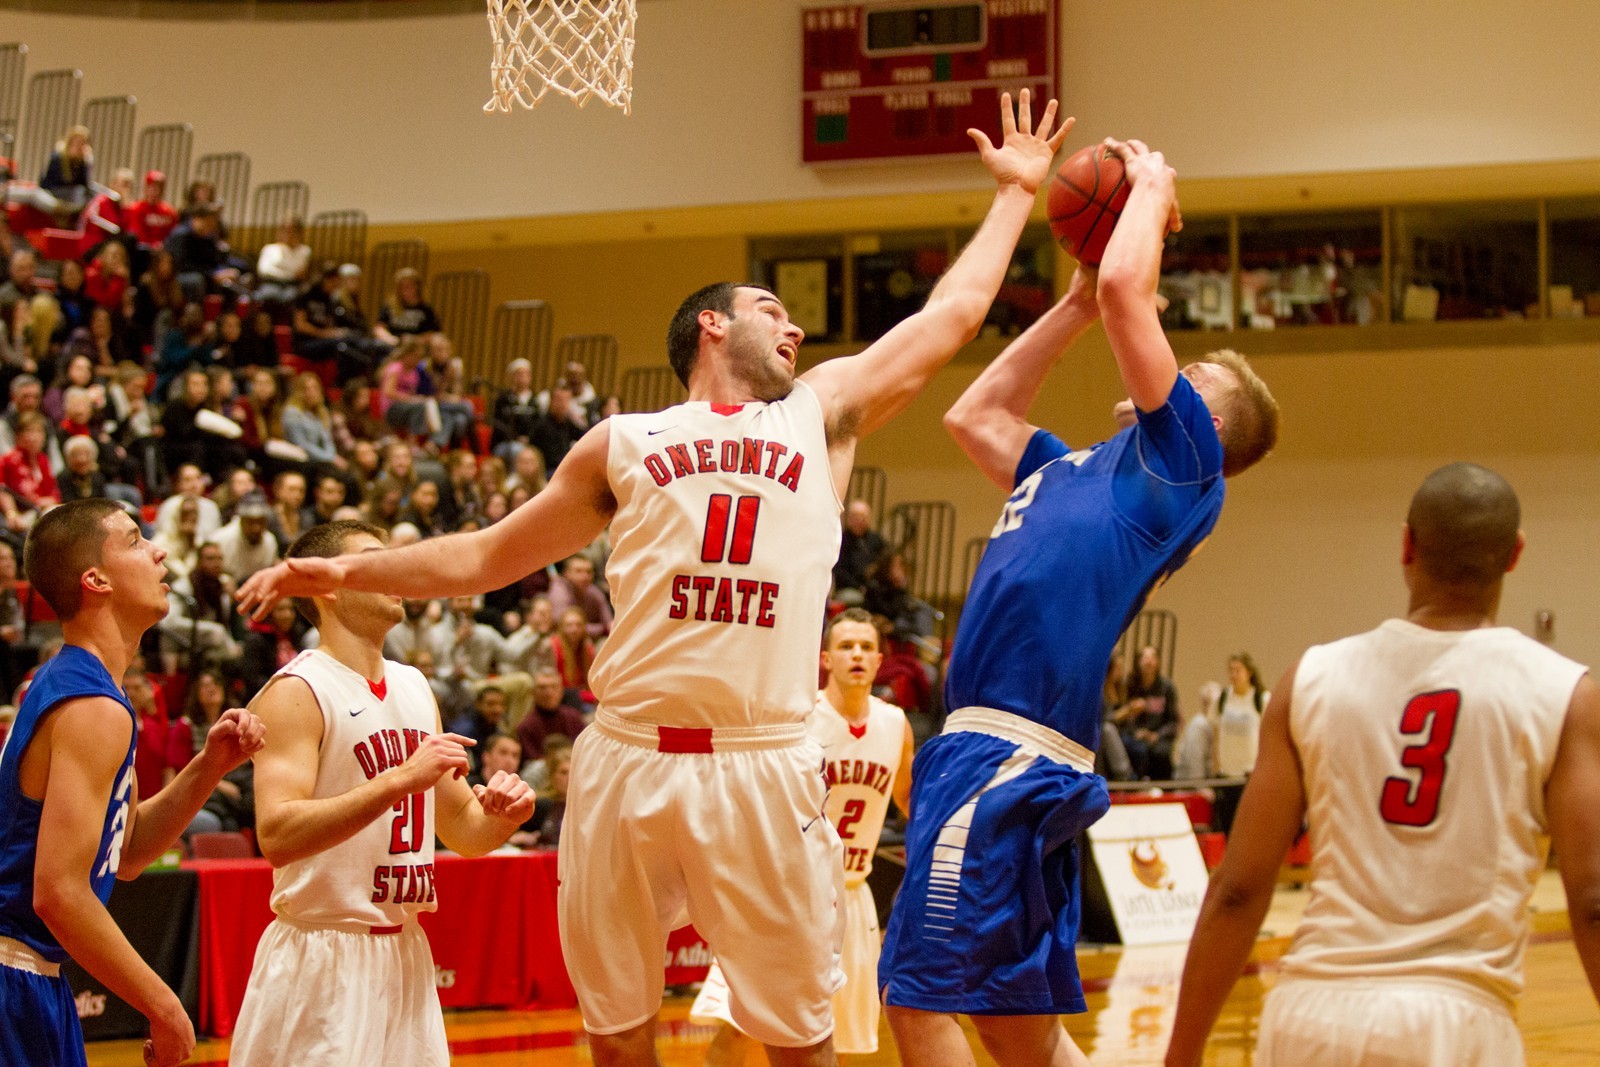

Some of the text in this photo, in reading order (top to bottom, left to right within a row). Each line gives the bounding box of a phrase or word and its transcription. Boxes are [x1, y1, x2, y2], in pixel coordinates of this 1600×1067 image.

[643, 437, 805, 493] ONEONTA
[700, 493, 761, 565] 11
[669, 574, 780, 628] STATE
[826, 759, 892, 797] NEONTA
[1379, 688, 1462, 827] 3
[388, 792, 425, 855] 21
[836, 798, 866, 839] 2
[371, 863, 435, 904] STATE
